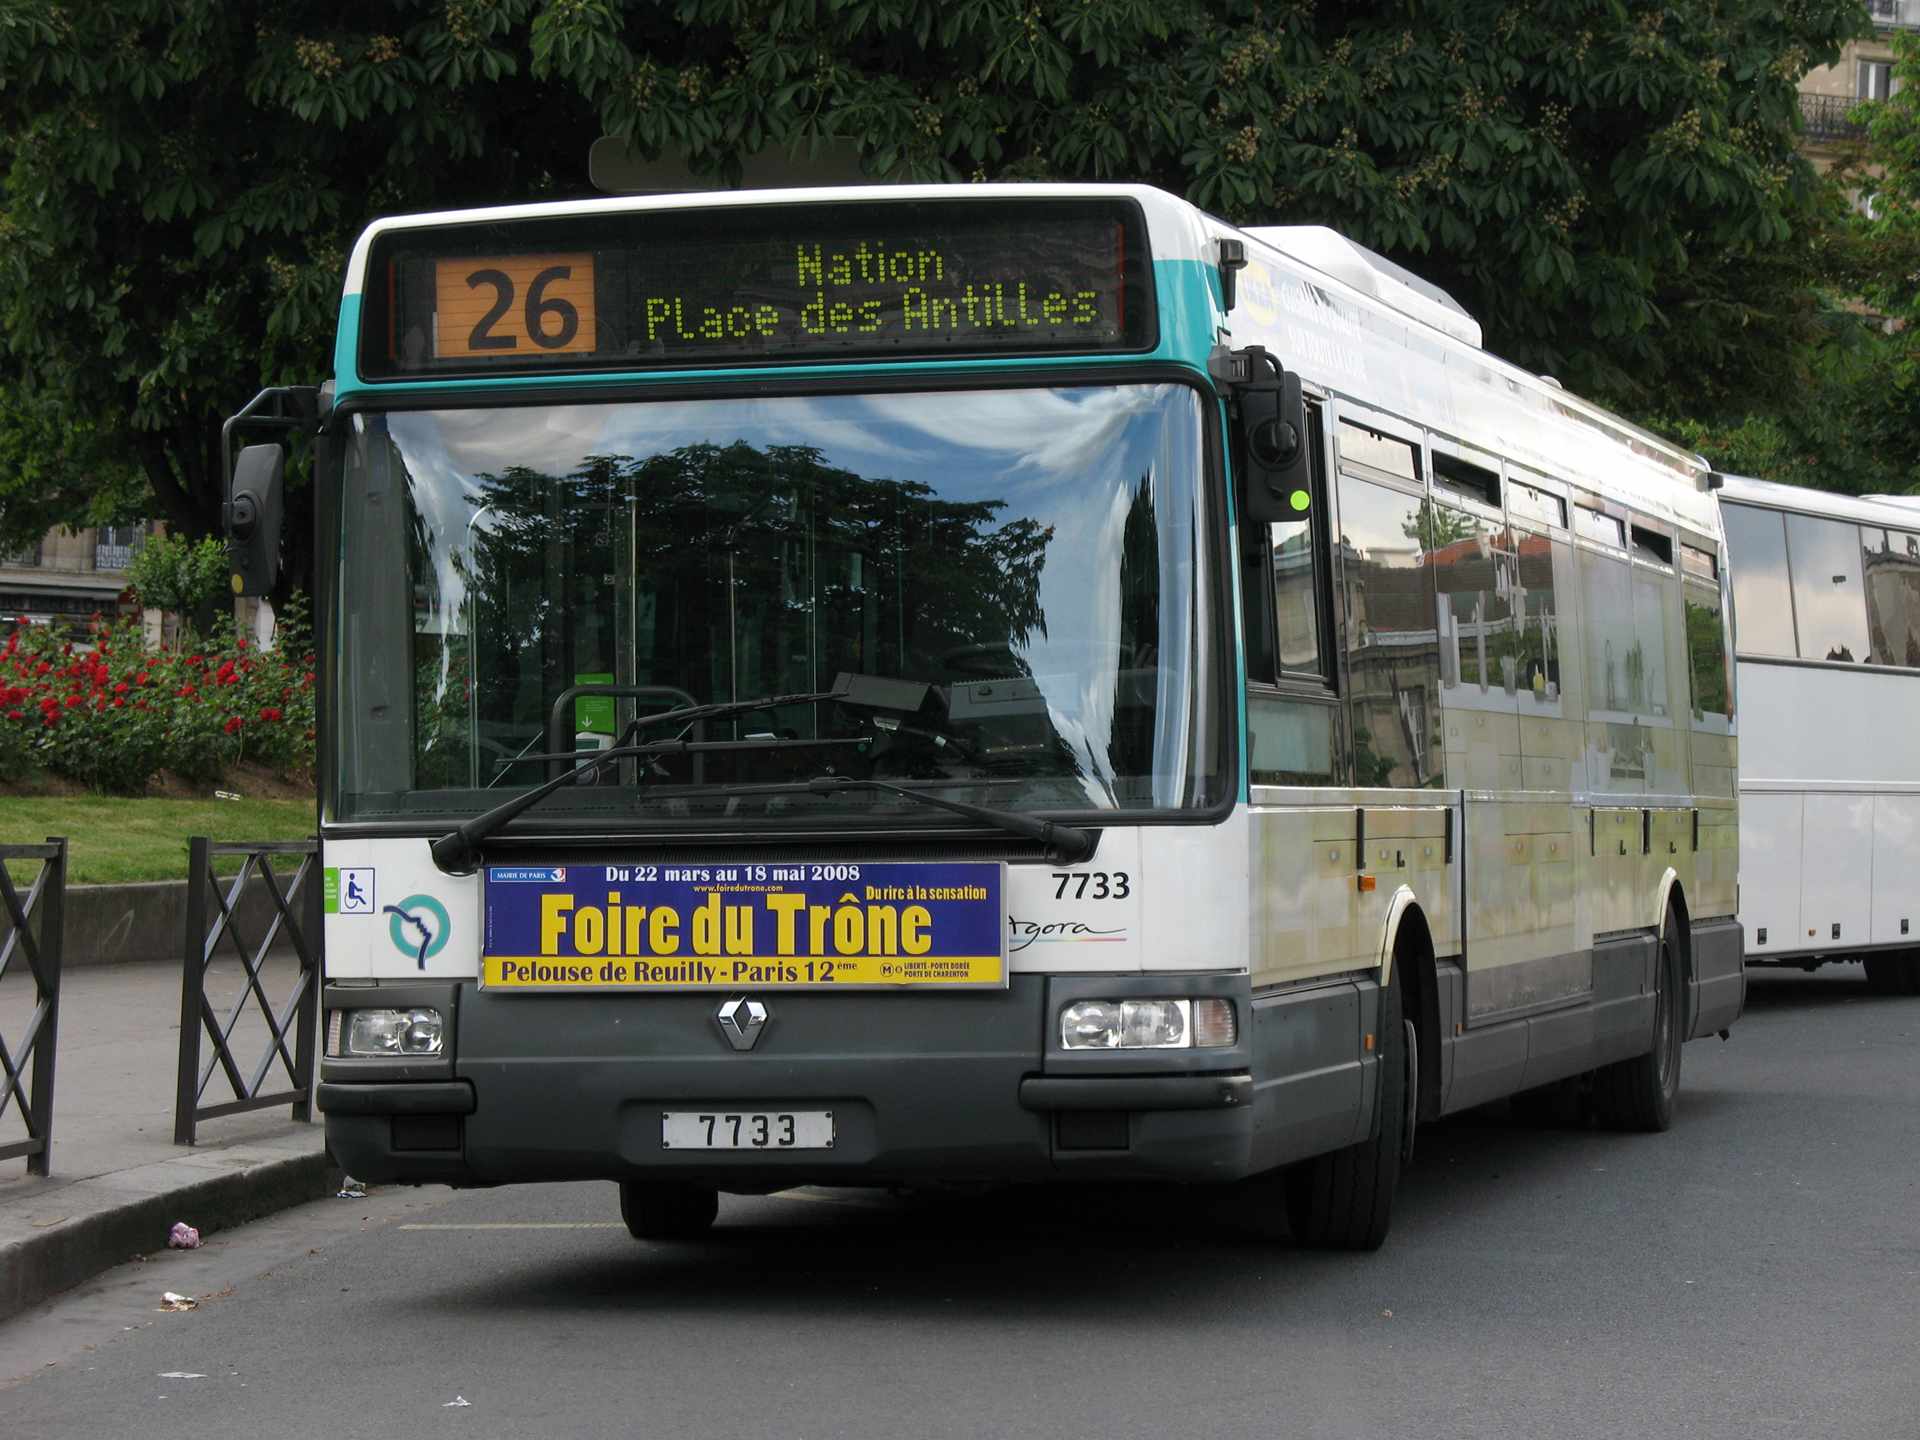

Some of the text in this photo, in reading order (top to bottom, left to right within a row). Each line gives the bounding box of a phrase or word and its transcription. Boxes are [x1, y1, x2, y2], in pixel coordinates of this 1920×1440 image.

[796, 243, 945, 288] Nation
[466, 265, 582, 352] 26
[645, 283, 1098, 342] Place des Antilles
[606, 866, 861, 882] Du 22 mars au 18 mai 2008
[1051, 872, 1130, 899] 7733
[865, 885, 987, 901] Du rire à la sensation
[540, 892, 681, 956] Foire
[692, 892, 754, 956] du
[766, 893, 933, 956] Trône
[501, 961, 593, 982] Pelouse
[599, 961, 627, 981] de
[633, 961, 717, 984] Reuilly
[732, 961, 799, 982] Paris
[699, 1115, 795, 1146] 7733
